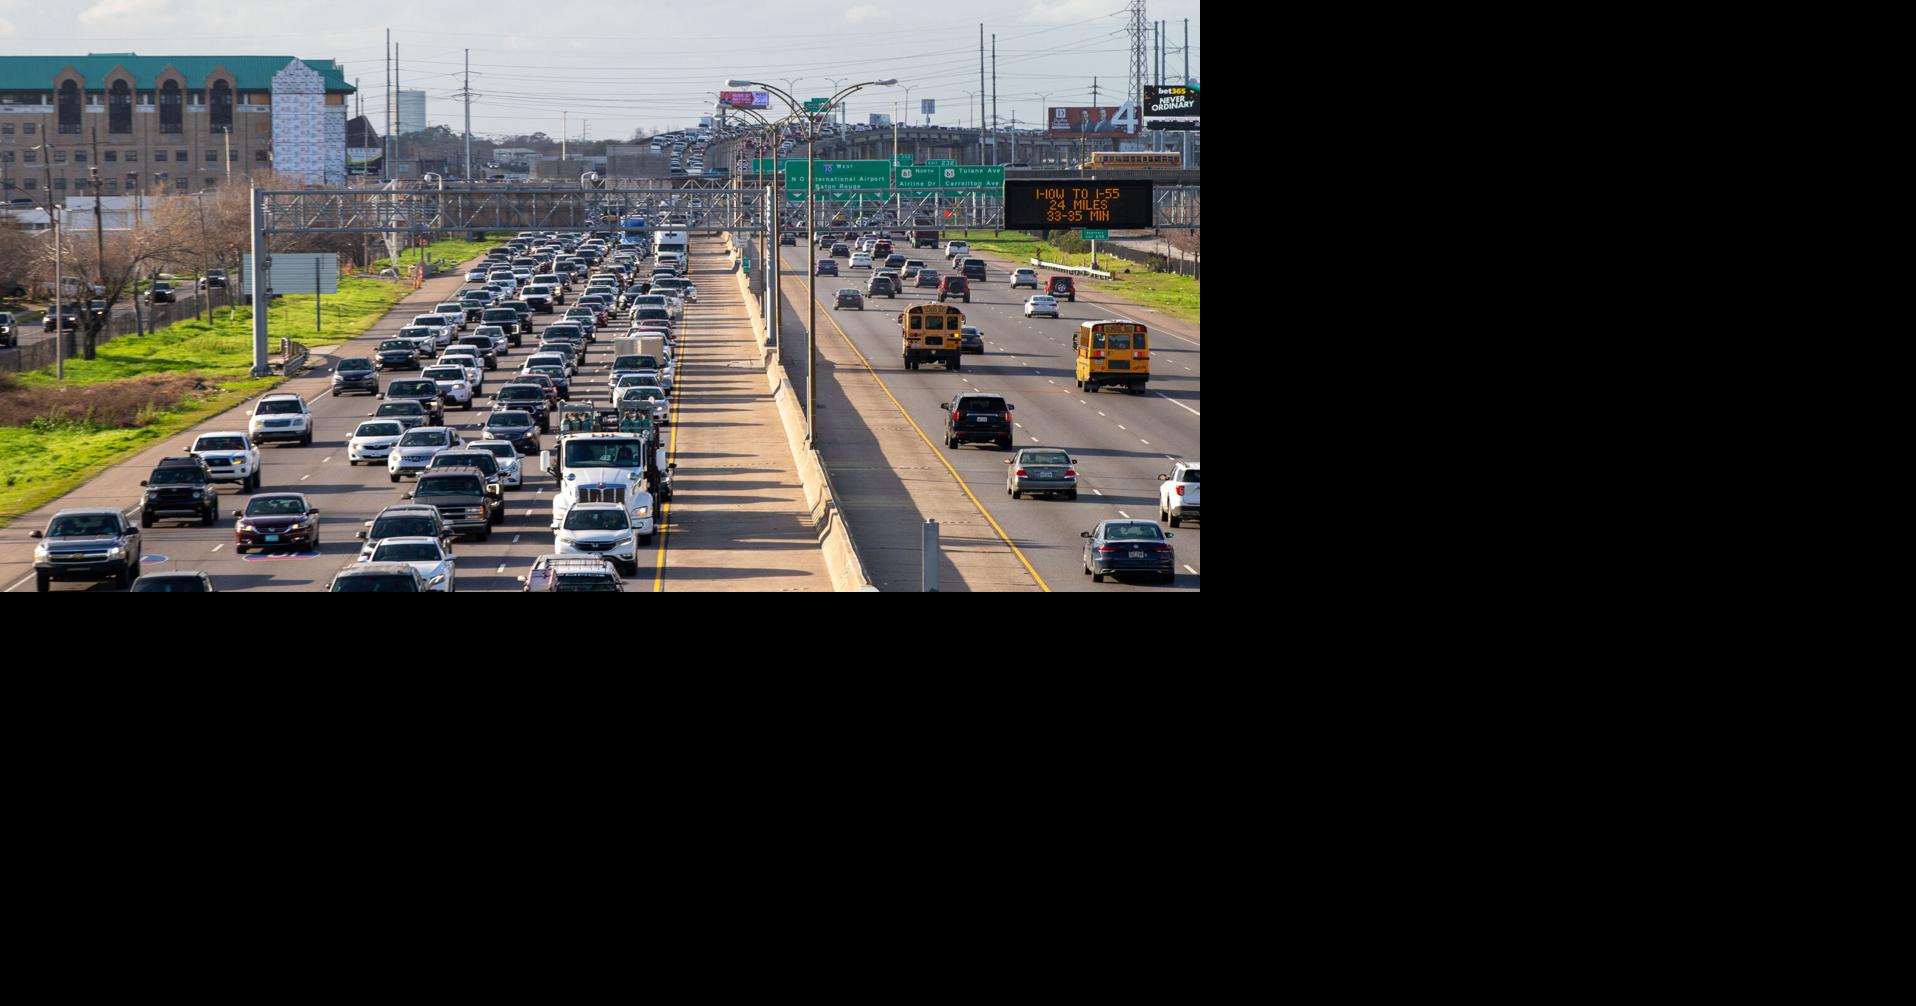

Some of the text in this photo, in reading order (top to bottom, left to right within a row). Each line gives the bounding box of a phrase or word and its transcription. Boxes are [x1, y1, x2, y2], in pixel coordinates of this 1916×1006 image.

[1158, 87, 1186, 95] bet365
[1159, 95, 1185, 104] NEVER
[1151, 100, 1194, 111] ORDINARY
[1110, 99, 1138, 134] 4
[941, 160, 955, 168] 232
[1072, 188, 1089, 200] TO
[1096, 188, 1121, 200] I-55
[1049, 200, 1108, 211] 24 MILES
[1047, 211, 1110, 222] 33-35 MIN
